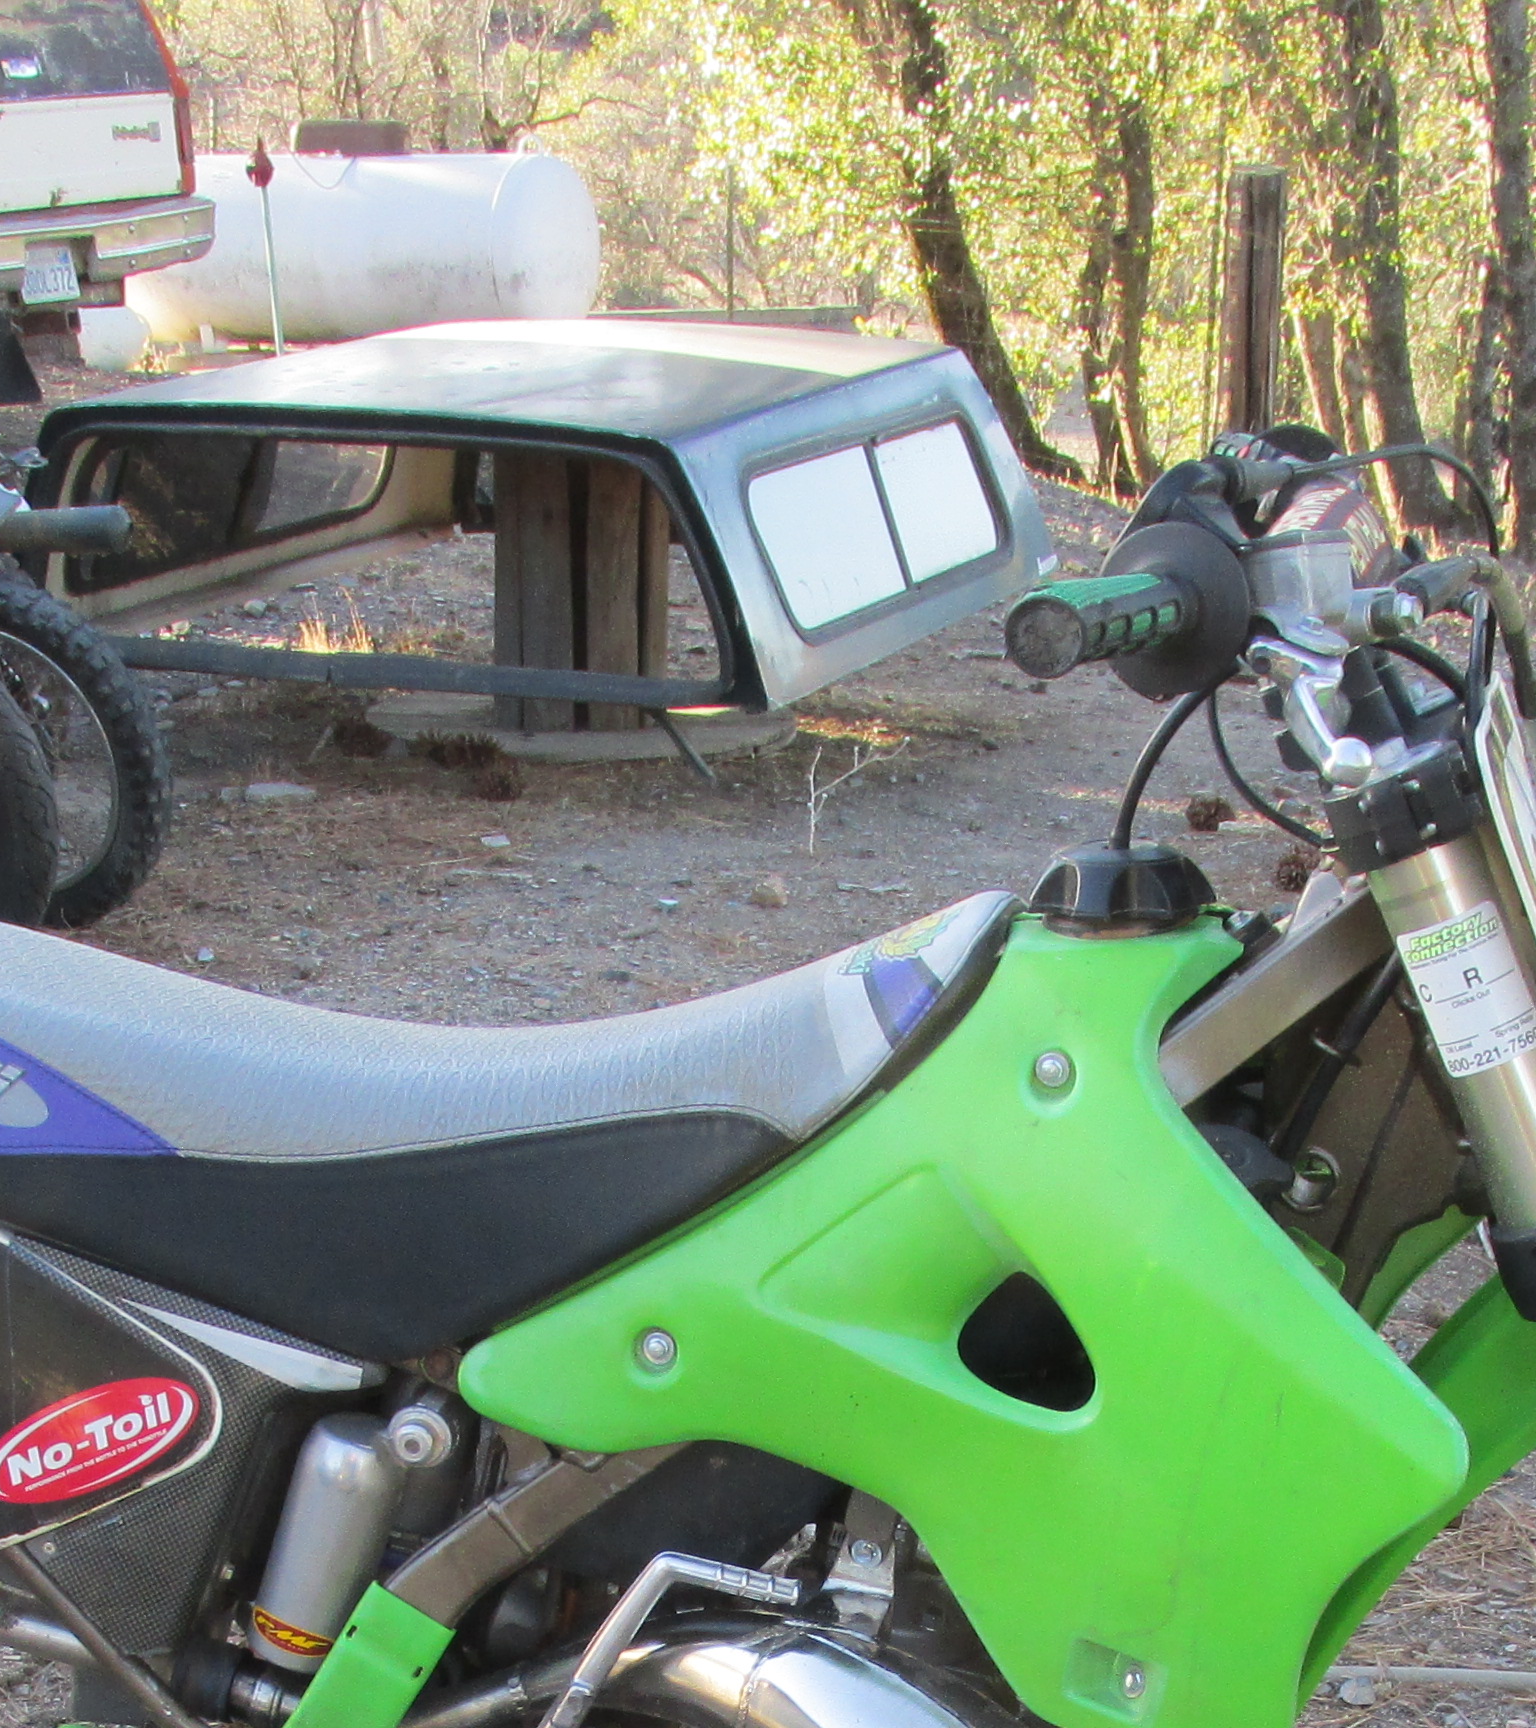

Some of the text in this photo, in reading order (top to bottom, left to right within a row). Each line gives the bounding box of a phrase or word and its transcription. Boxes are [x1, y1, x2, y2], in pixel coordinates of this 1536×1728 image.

[1405, 918, 1498, 964] Connection
[1409, 912, 1483, 950] Factory
[1419, 967, 1483, 1003] C R
[7, 1391, 171, 1487] No-Toil
